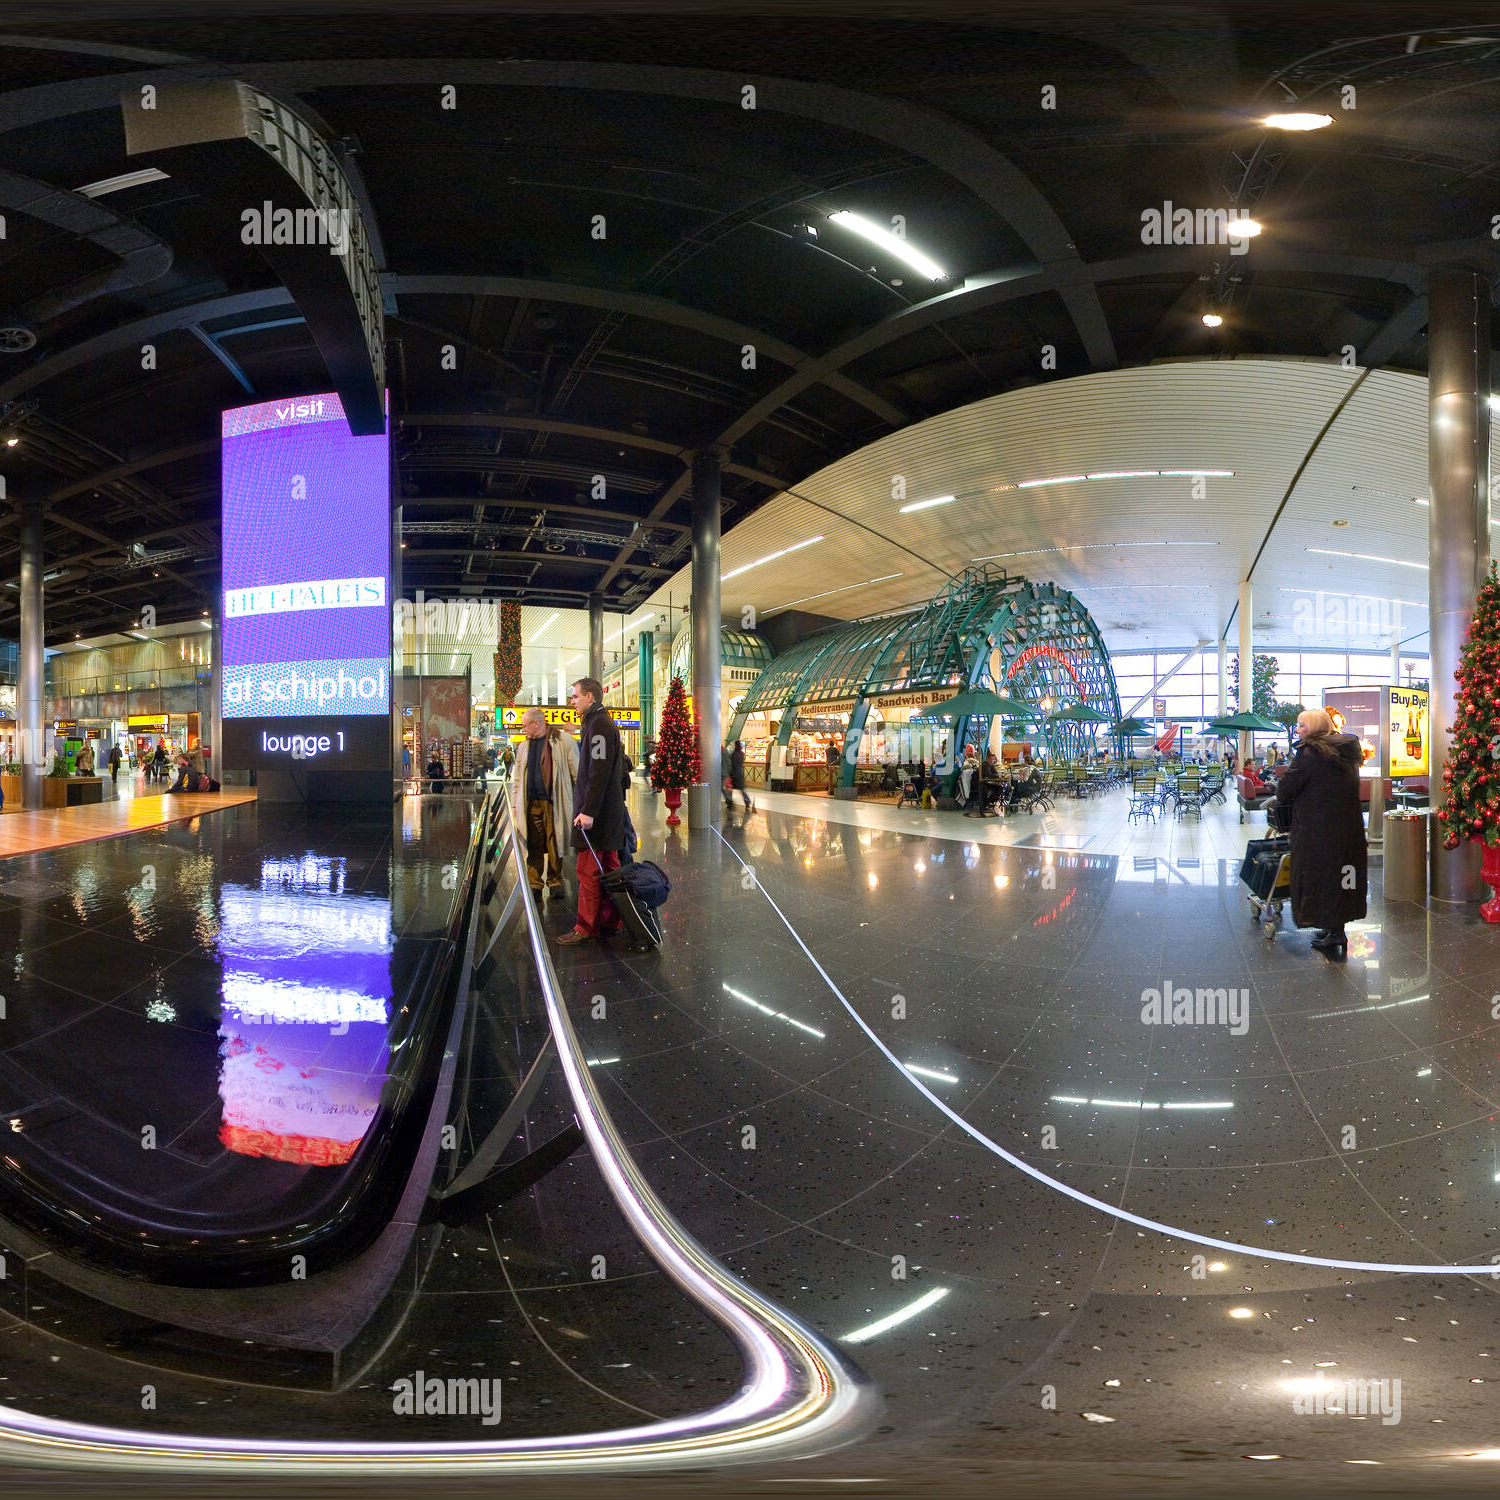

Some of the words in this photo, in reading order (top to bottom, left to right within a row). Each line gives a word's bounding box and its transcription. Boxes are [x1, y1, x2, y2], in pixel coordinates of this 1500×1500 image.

[275, 399, 326, 421] visit
[289, 581, 381, 607] PALEIS
[226, 678, 251, 702] at
[260, 668, 385, 707] schiphol
[801, 702, 854, 715] Mediterranean
[877, 694, 928, 708] Sandwich
[931, 692, 953, 703] Bar
[1391, 692, 1411, 708] Buy
[1411, 694, 1428, 709] Bye!
[262, 731, 331, 759] lounge
[336, 731, 345, 752] 1
